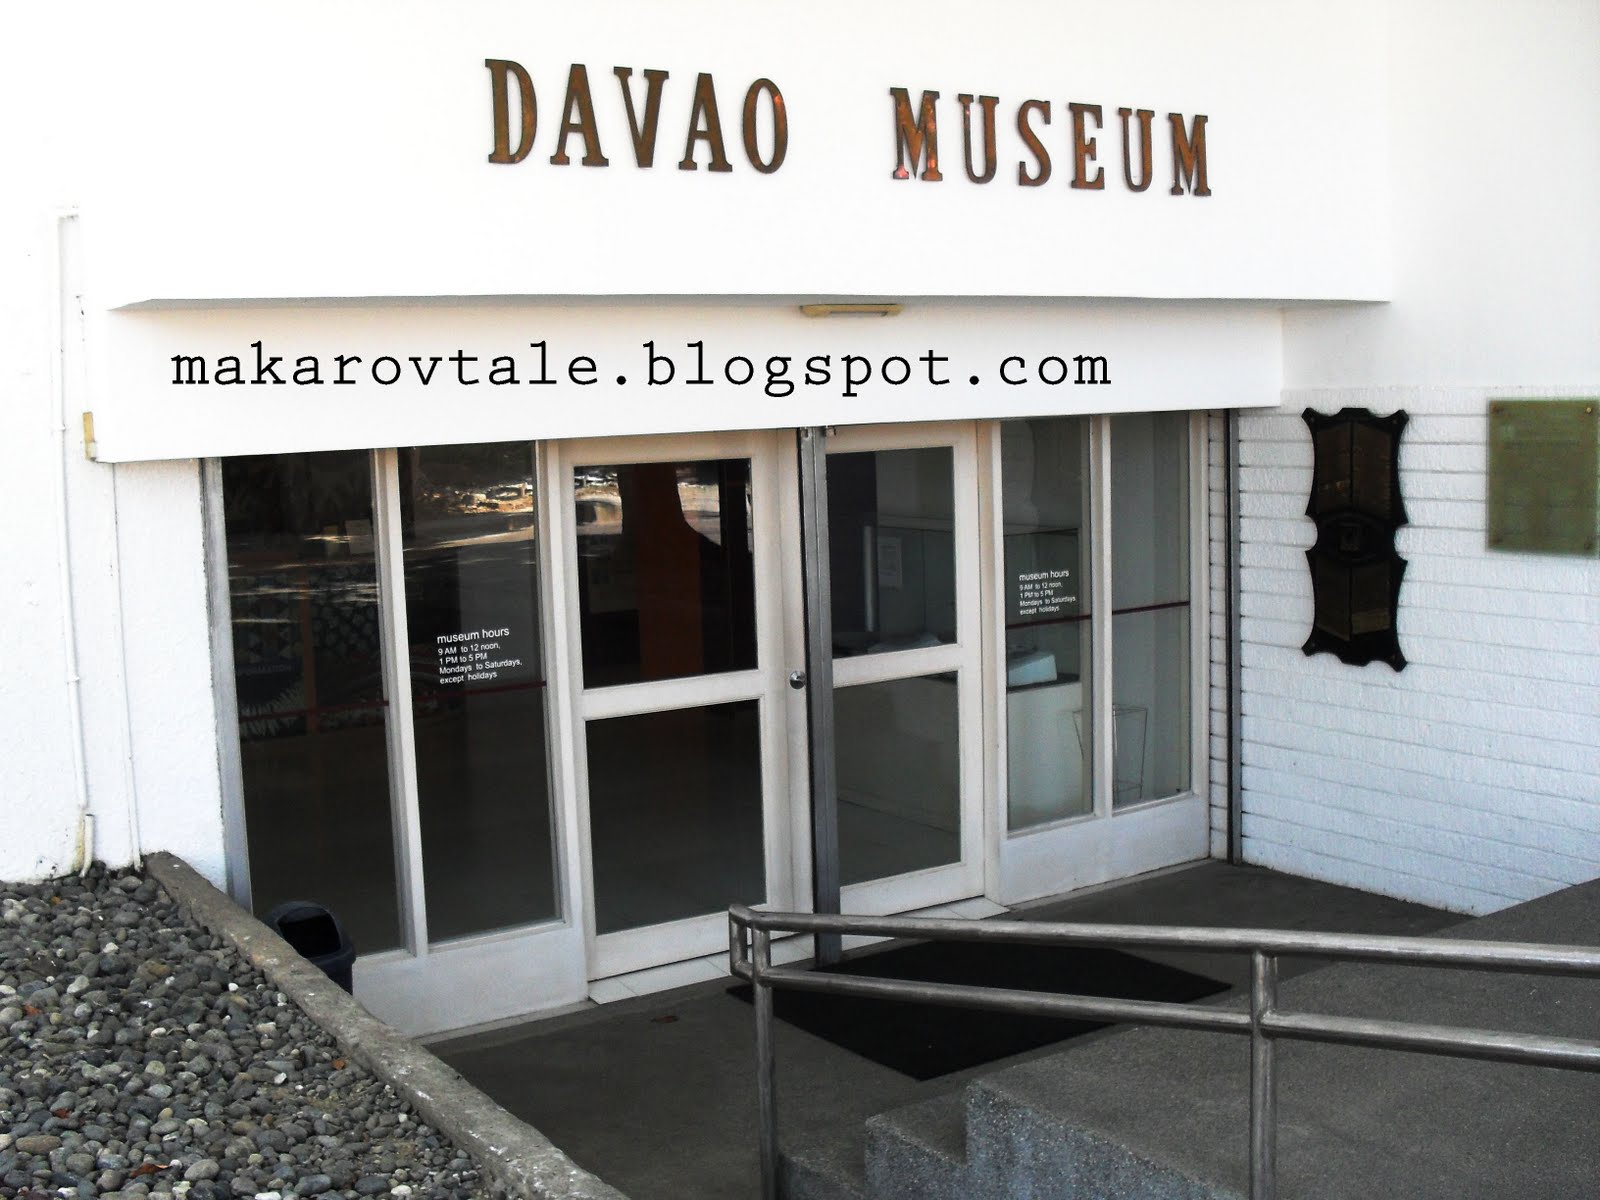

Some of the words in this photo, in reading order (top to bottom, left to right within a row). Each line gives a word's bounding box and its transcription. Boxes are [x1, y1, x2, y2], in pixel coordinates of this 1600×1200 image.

[485, 59, 788, 174] DAVAO
[890, 87, 1211, 197] MUSEUM
[1019, 572, 1049, 581] museum
[1050, 570, 1070, 578] hours
[1020, 607, 1037, 616] except
[1039, 605, 1060, 613] holidays
[437, 631, 480, 644] museum
[481, 628, 510, 639] hours
[438, 648, 444, 656] 9
[444, 646, 457, 655] AM
[461, 645, 468, 653] to
[470, 644, 479, 652] 12
[459, 655, 467, 663] to
[468, 653, 474, 662] 5
[439, 664, 472, 675] Mondays
[440, 676, 465, 685] except
[467, 670, 498, 682] holidays
